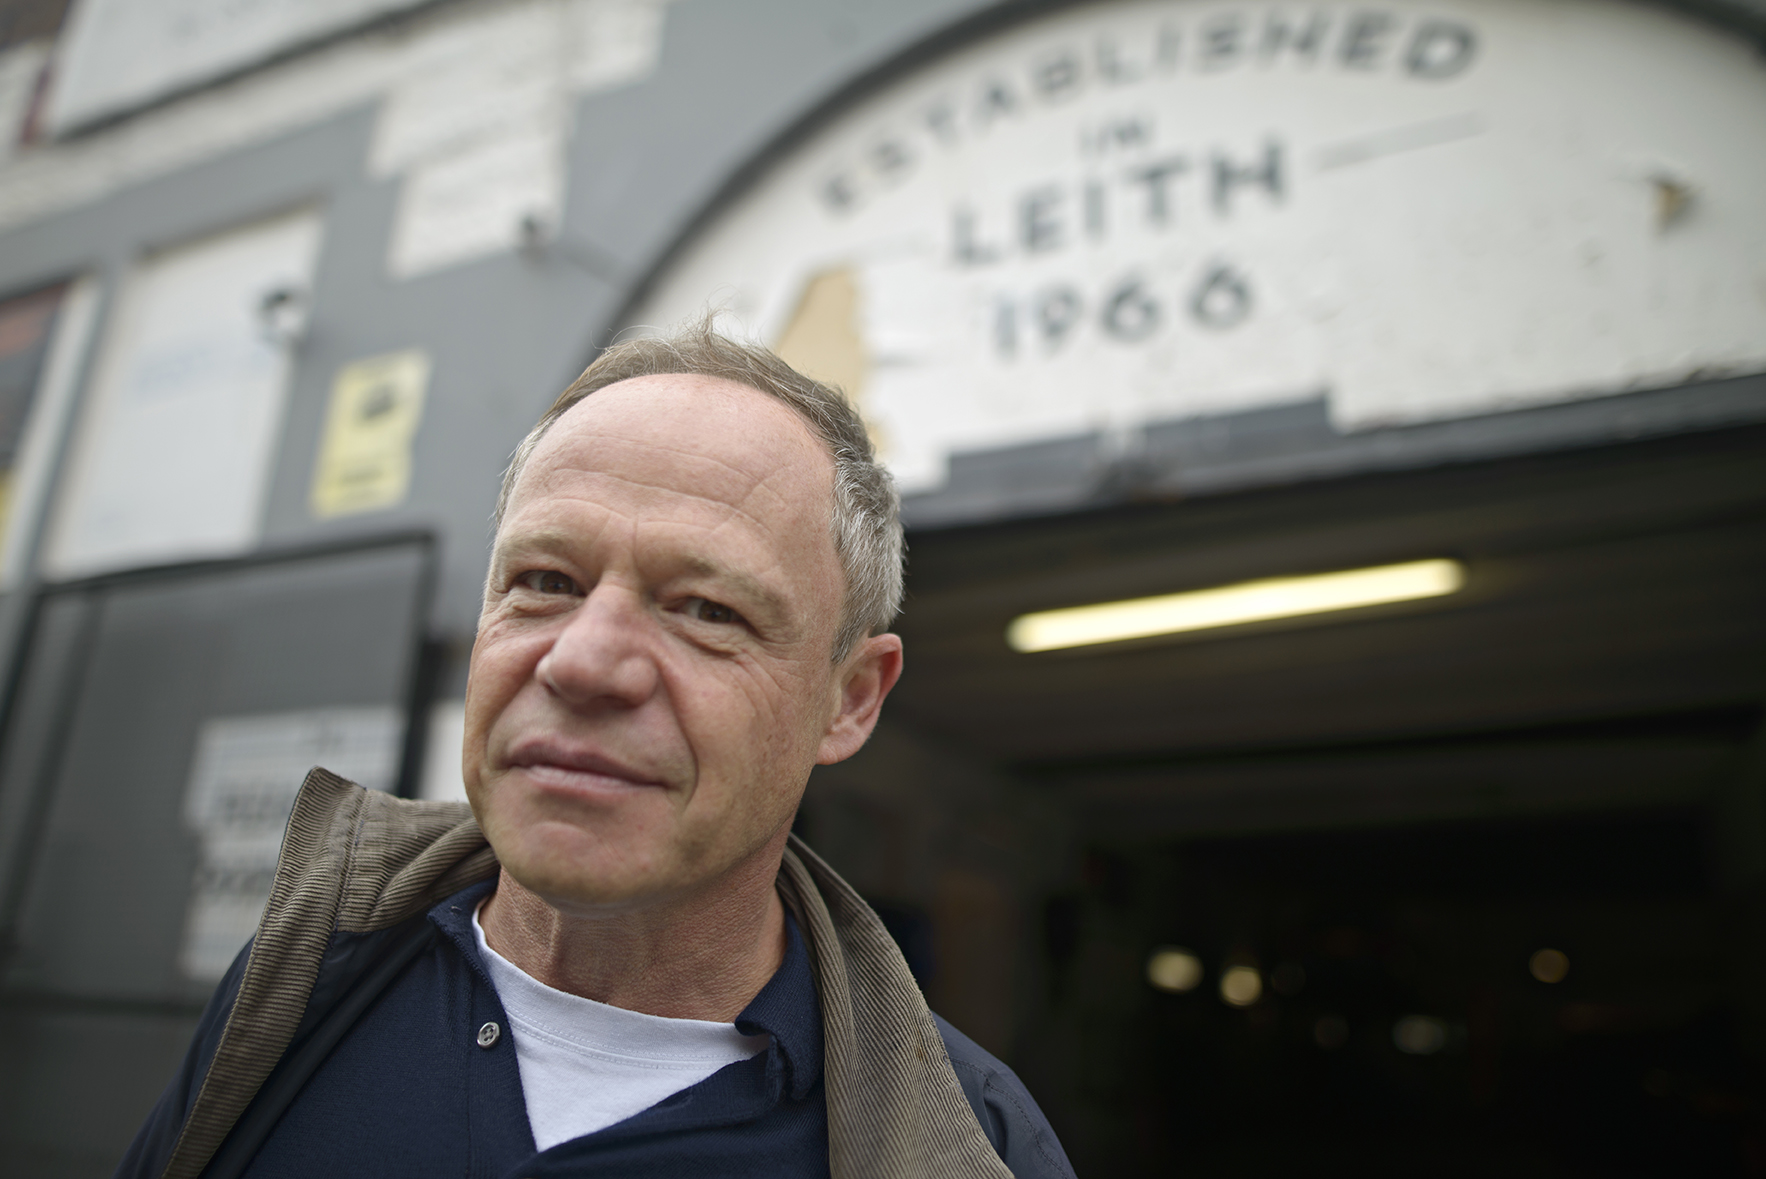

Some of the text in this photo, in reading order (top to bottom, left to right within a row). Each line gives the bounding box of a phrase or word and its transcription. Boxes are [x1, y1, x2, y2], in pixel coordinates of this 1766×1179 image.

[816, 9, 1480, 217] ESTABLISHED
[1080, 113, 1155, 157] IN
[948, 131, 1290, 268] LEITH
[990, 257, 1258, 363] 1966
